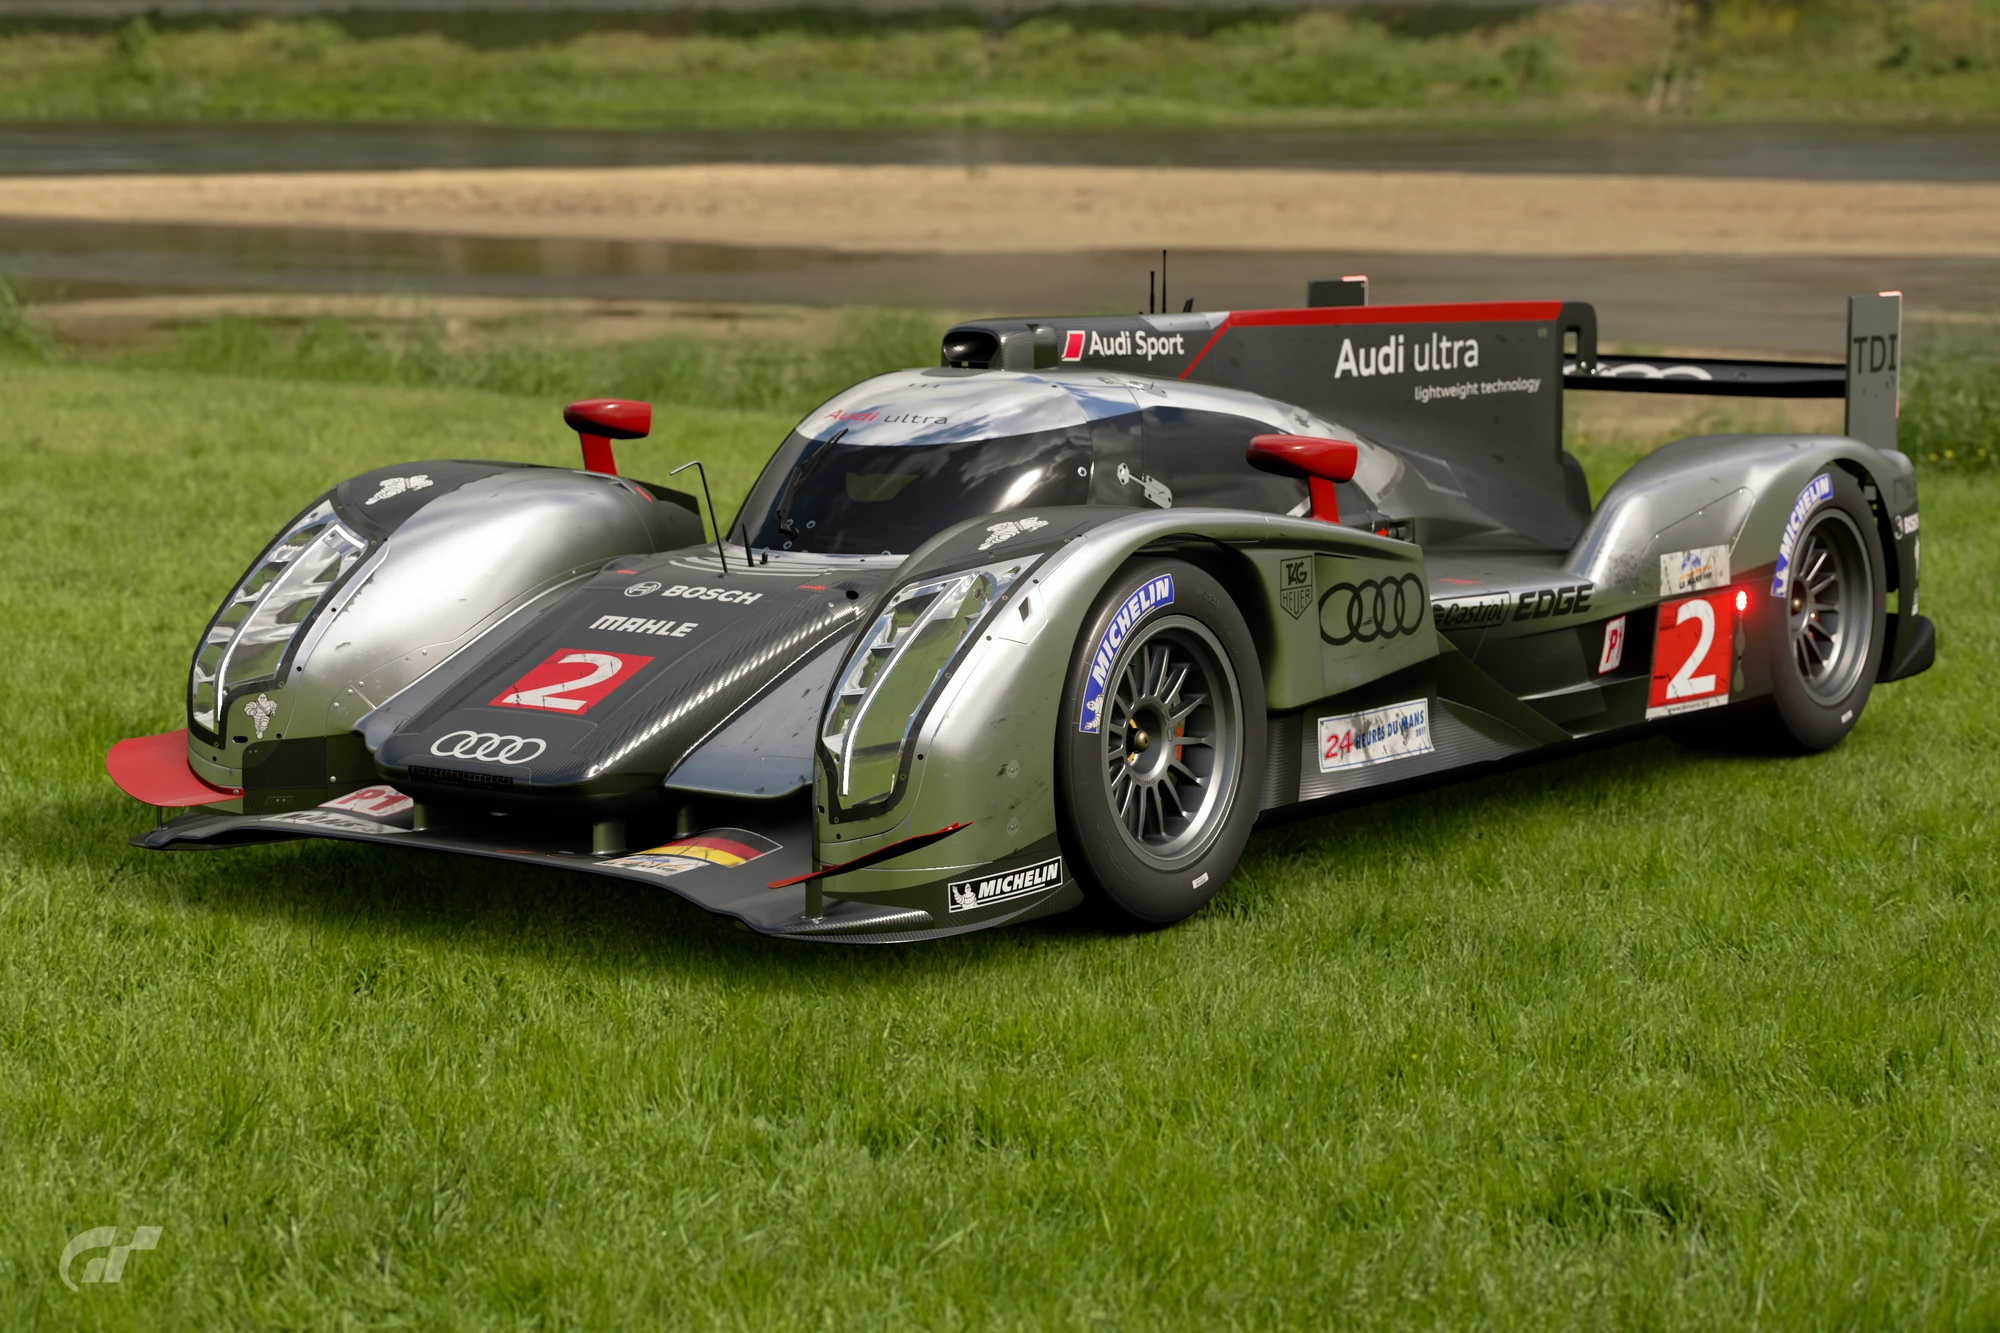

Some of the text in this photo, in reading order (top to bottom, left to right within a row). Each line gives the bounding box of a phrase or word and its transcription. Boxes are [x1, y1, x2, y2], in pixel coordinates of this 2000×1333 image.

[1088, 330, 1185, 361] Audi Sport
[1334, 332, 1479, 379] Audi ultra
[1853, 334, 1897, 374] TDI
[1413, 377, 1541, 403] lightweight technology
[824, 409, 948, 425] Audi ultra
[1779, 477, 1830, 562] MICHELIN
[1286, 561, 1308, 586] TAG
[660, 585, 764, 605] BOSCH
[1283, 589, 1311, 615] HEUER
[1443, 584, 1594, 626] Castrol EDGE
[588, 615, 699, 637] MAHLE
[1091, 577, 1170, 688] MICHELIN
[1606, 627, 1623, 664] P1
[1666, 599, 1716, 699] 2
[501, 653, 623, 711] 2
[1324, 709, 1425, 760] 24 HEURES DU MANS
[335, 789, 409, 812] P1
[978, 862, 1059, 899] MICHELIN
